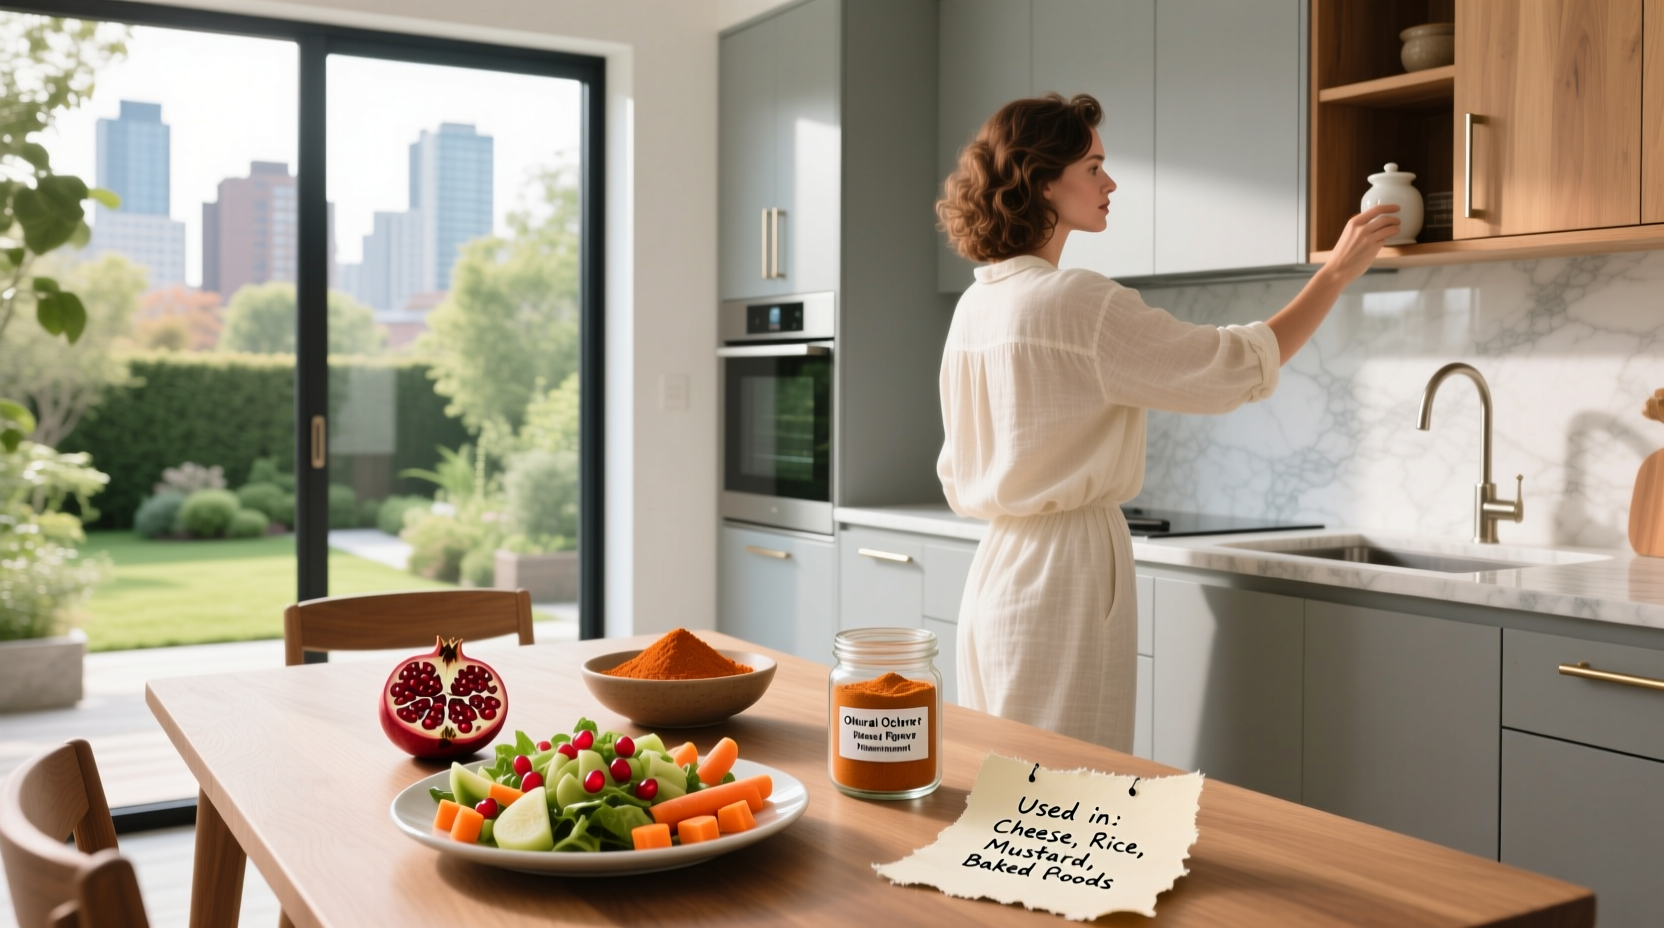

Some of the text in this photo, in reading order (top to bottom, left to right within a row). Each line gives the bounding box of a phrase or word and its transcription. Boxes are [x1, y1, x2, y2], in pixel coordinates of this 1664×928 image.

[1017, 796, 1121, 827] Used in:
[983, 838, 1094, 871] Mustard,
[993, 819, 1144, 859] Cheese, Rice,
[961, 853, 1037, 878] Baked
